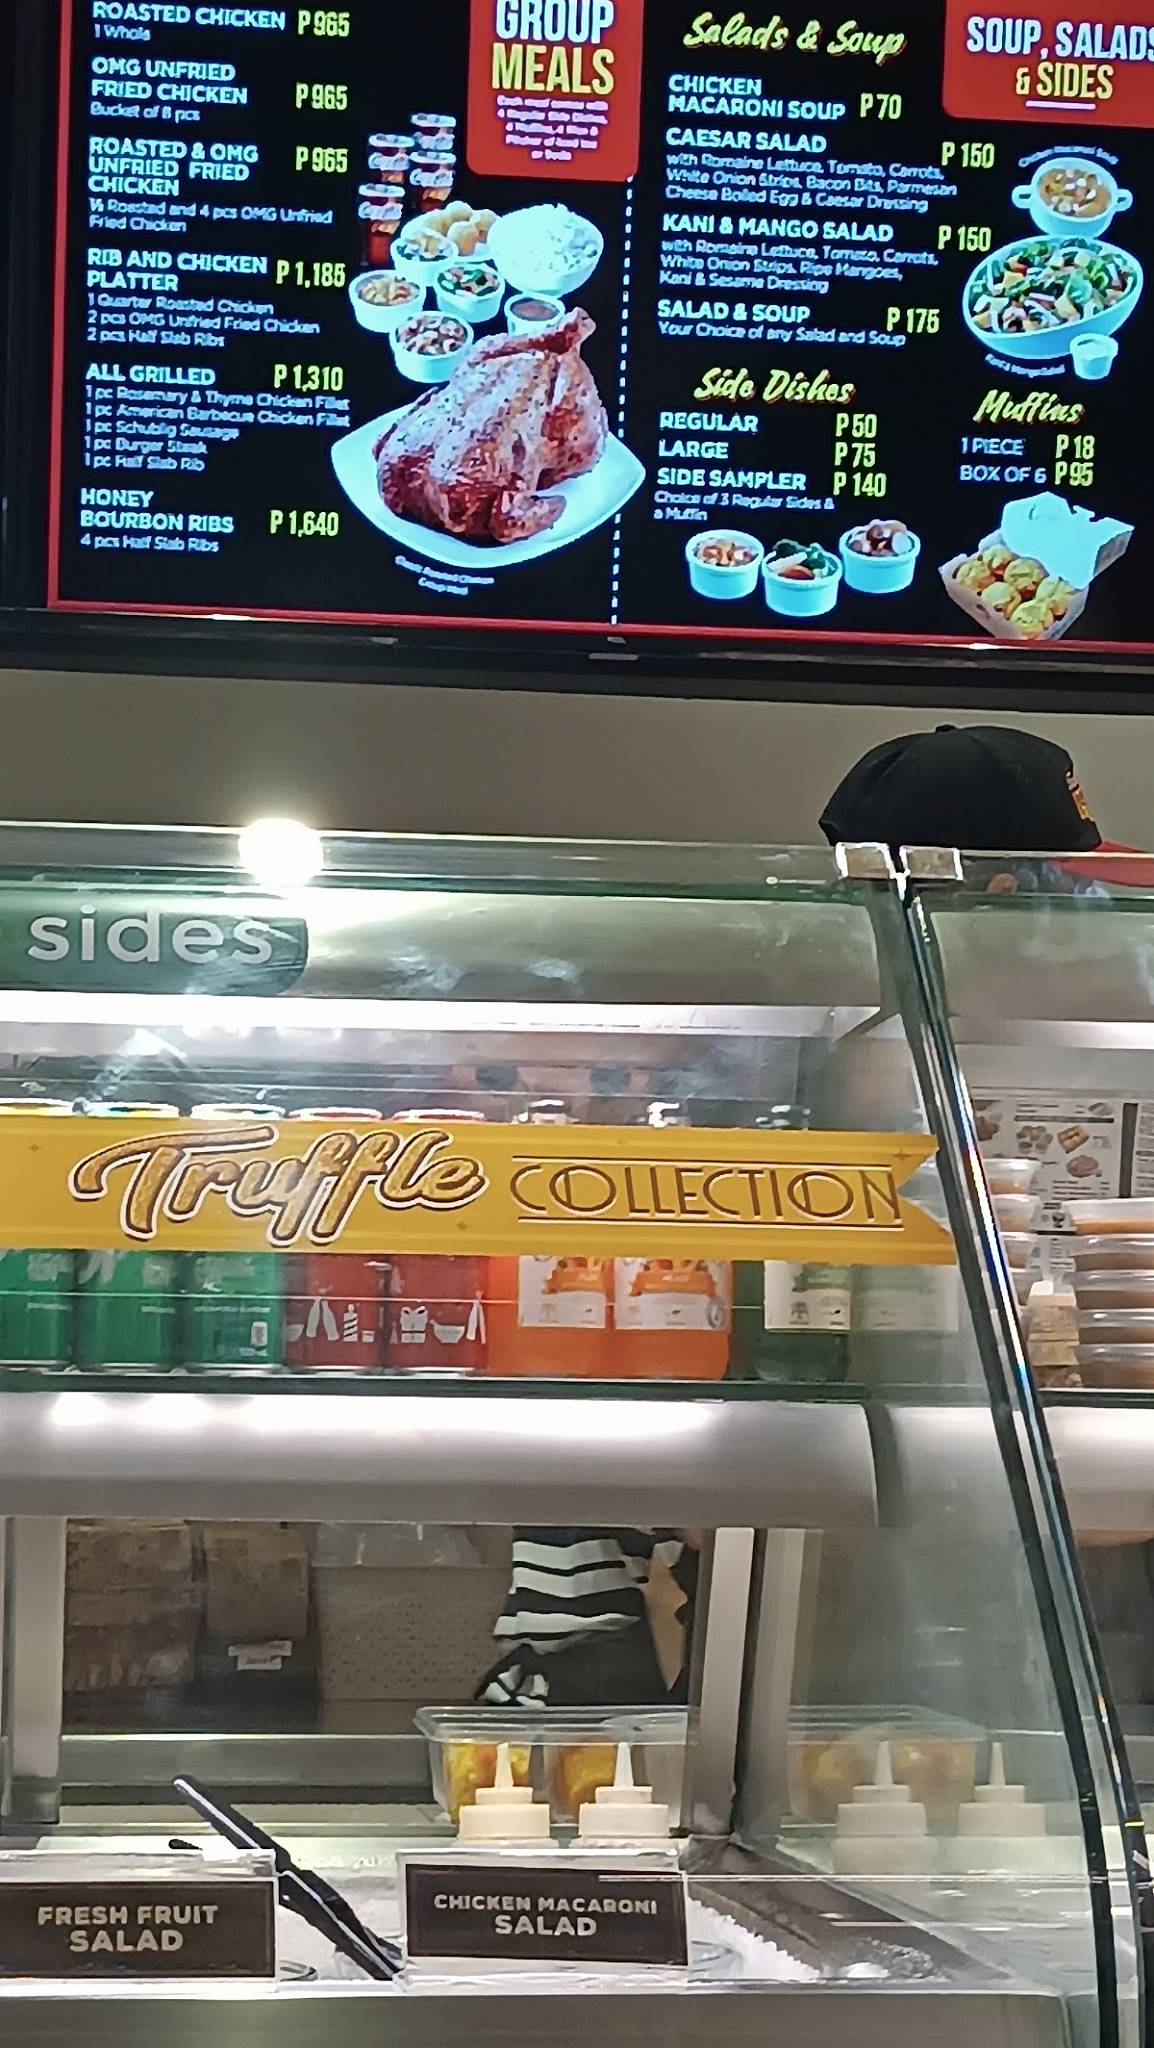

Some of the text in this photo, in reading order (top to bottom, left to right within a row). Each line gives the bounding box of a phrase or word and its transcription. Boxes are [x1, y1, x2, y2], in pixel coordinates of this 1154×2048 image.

[92, 1, 286, 30] ROASTED CHICKEN
[496, 0, 614, 43] GROUP
[683, 11, 907, 66] Salads & Soup
[966, 16, 1049, 60] SOUP,
[145, 59, 236, 82] UNFRIED
[492, 42, 615, 95] MEALS
[1016, 61, 1114, 99] & SIDES
[91, 79, 248, 104] FRIED CHICKEN
[668, 74, 762, 95] CHICKEN
[668, 95, 846, 120] MACARONI SOUP
[89, 136, 187, 159] ROASTED
[666, 127, 827, 153] CAESAR SALAD
[89, 156, 249, 181] UNFRIED FRIED
[88, 176, 179, 196] CHICKEN
[662, 213, 714, 234] KANI
[738, 218, 818, 239] MANGO
[822, 221, 894, 242] SALAD
[87, 247, 268, 275] RIB AND CHICKEN
[87, 270, 178, 292] PLATTER
[657, 300, 729, 319] SALAD
[753, 304, 810, 323] SOUP
[86, 363, 216, 386] ALL GRILLED
[694, 368, 855, 405] Side Dishes
[973, 390, 1087, 424] Muffins
[660, 411, 759, 433] REGULAR
[658, 439, 729, 459] LARGE
[972, 438, 1025, 456] PIECE
[656, 467, 807, 490] SIDE SAMPLER
[960, 465, 1000, 482] BOX
[1004, 466, 1030, 482] OF
[80, 487, 153, 508] HONEY
[80, 509, 234, 534] BOURBON RIBS
[27, 904, 273, 964] sides
[68, 1125, 901, 1247] Truffle COLLECTION
[37, 1905, 218, 1927] FRESH FRUIT
[433, 1894, 657, 1915] CHICKEN MACARONI
[494, 1914, 598, 1937] SALAD
[69, 1929, 184, 1953] SALAD
